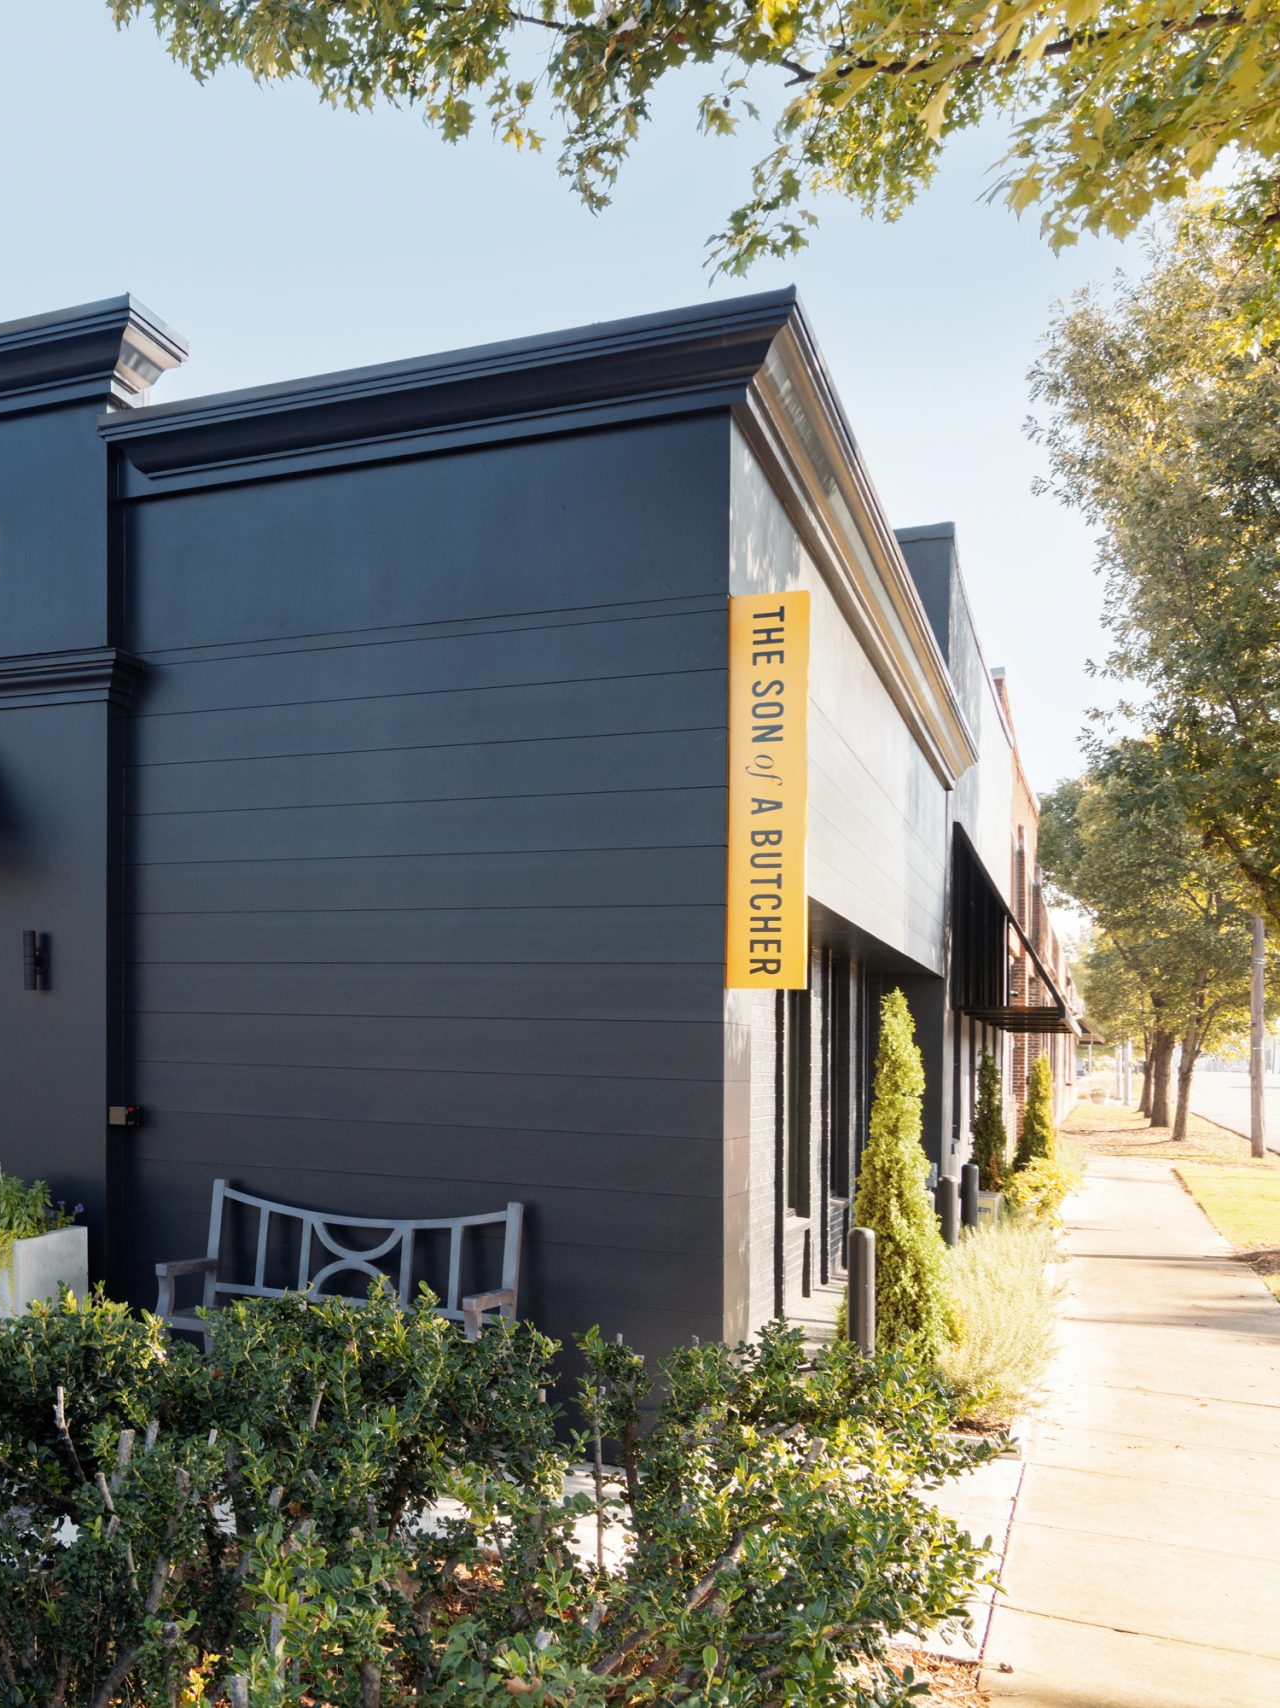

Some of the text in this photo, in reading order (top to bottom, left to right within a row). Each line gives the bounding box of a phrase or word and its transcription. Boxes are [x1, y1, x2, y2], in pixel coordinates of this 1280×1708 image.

[745, 605, 785, 975] THE SON of A BUTCHER
